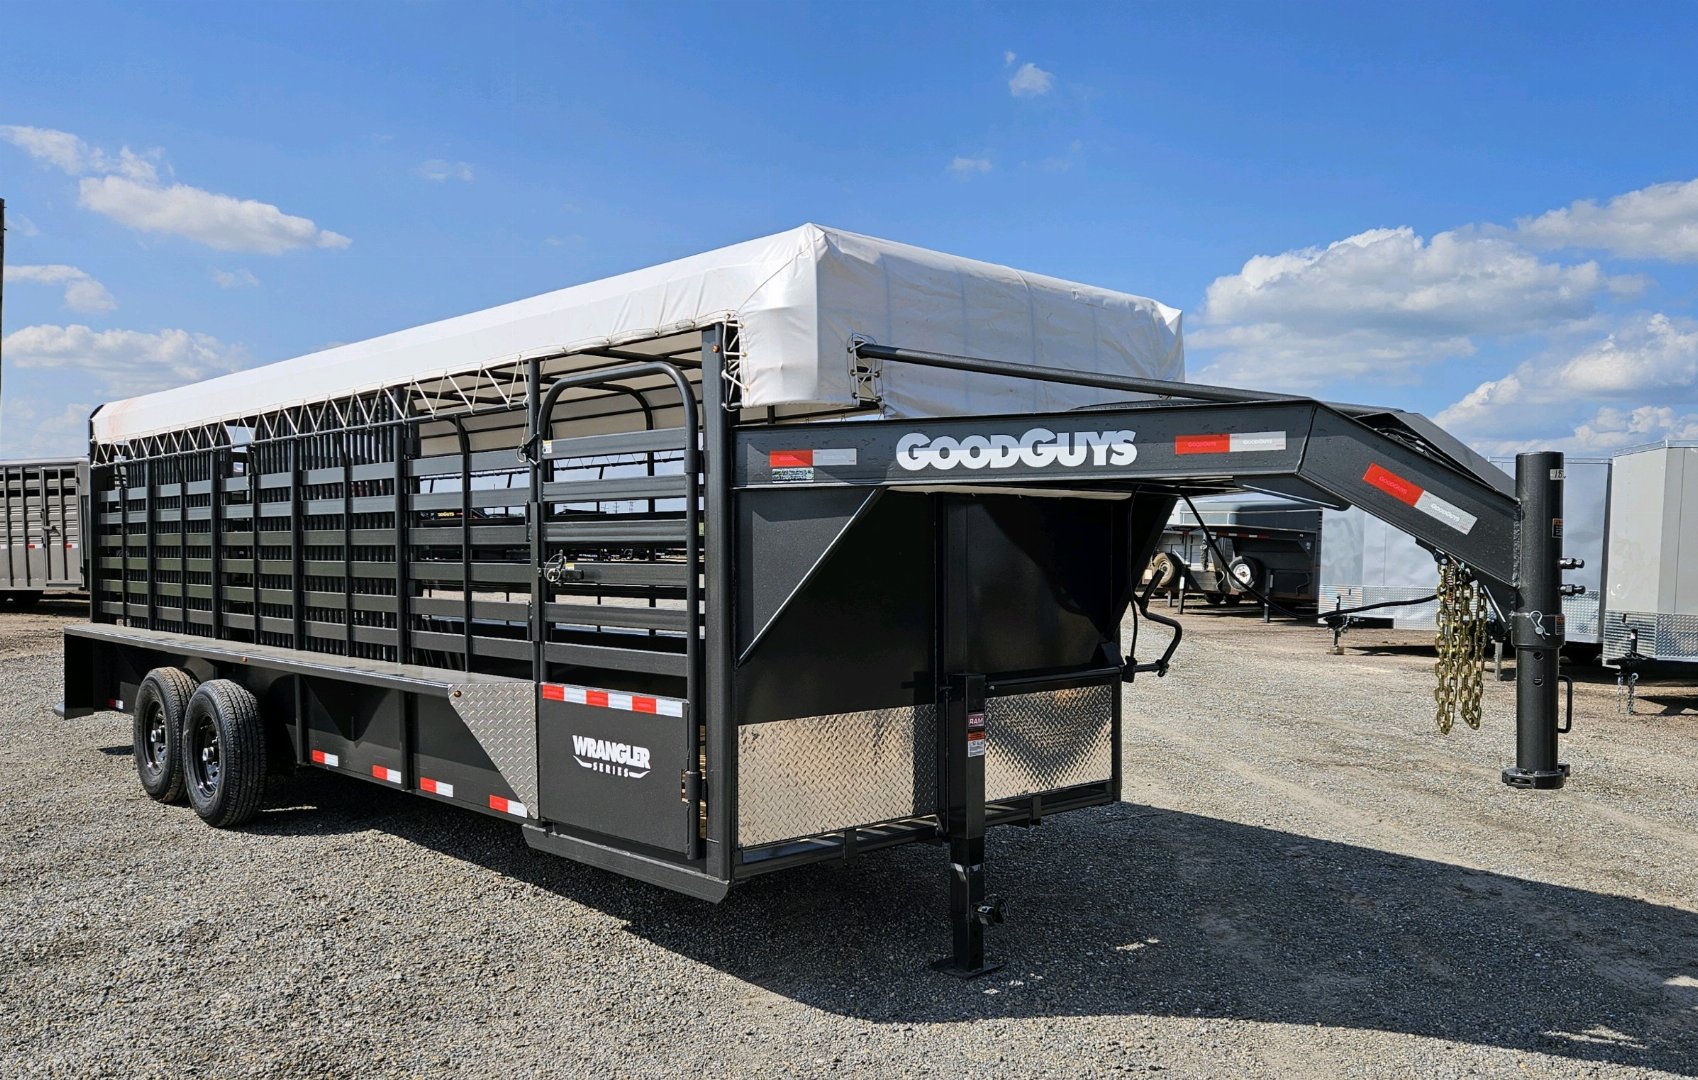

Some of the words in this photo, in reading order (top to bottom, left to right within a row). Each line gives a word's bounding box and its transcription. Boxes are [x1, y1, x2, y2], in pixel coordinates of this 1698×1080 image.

[896, 428, 1138, 471] GOODGUYS
[572, 735, 651, 769] WRANGLER
[592, 762, 629, 778] SERIES
